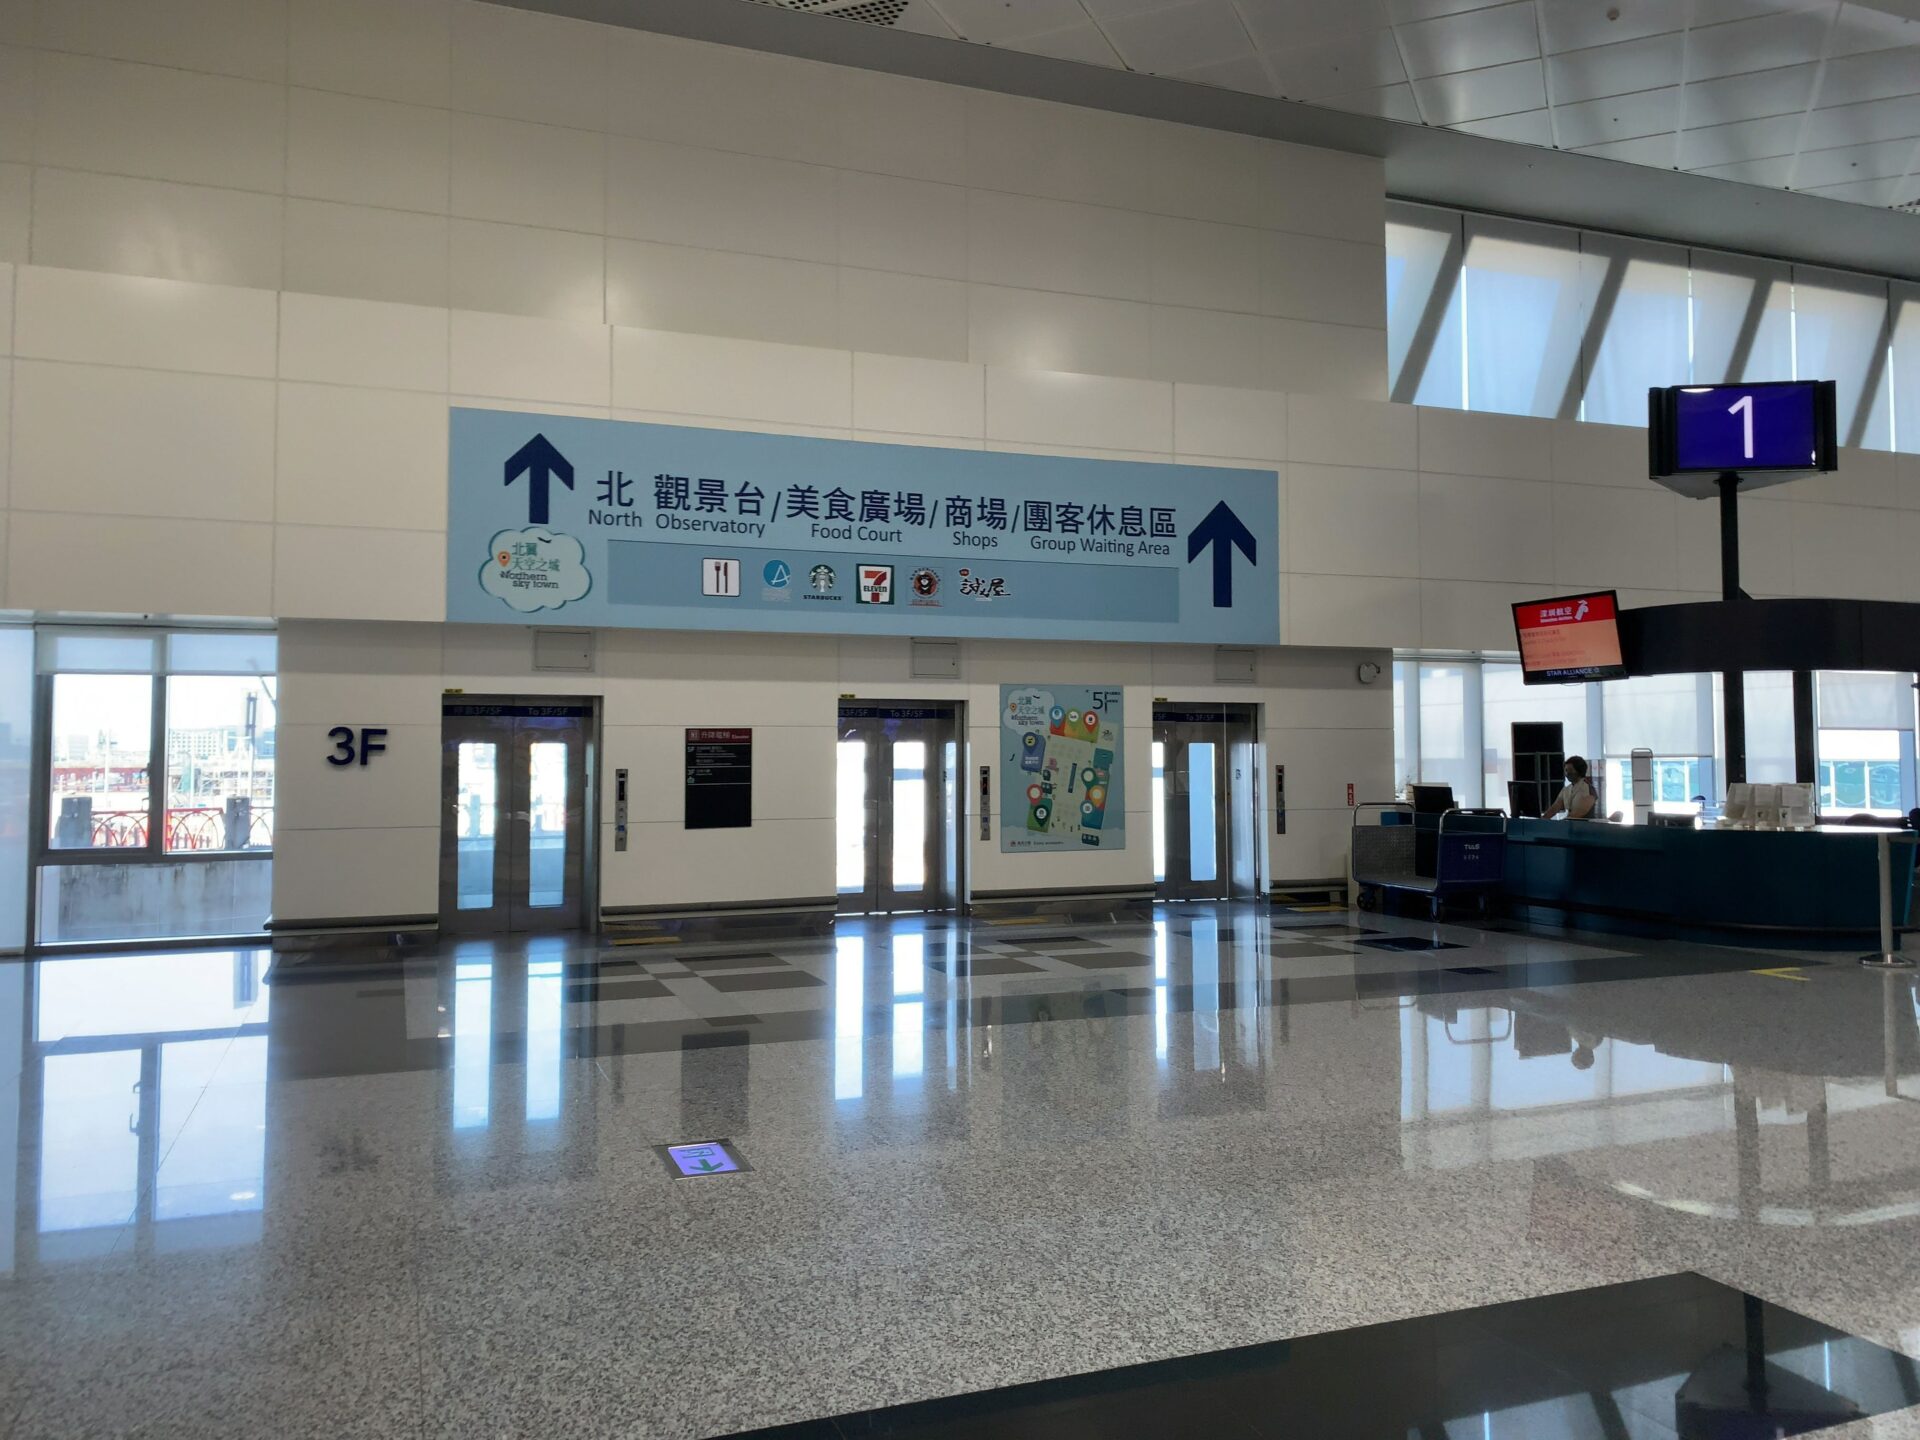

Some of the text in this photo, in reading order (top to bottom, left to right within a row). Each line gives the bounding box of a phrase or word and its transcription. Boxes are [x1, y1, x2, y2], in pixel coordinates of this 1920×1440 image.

[1727, 395, 1754, 459] 1
[597, 470, 634, 507] 北
[588, 509, 766, 538] North Observatory
[811, 523, 903, 543] Food Court
[953, 531, 998, 550] Shops
[1030, 535, 1170, 557] Group Waiting Area
[512, 580, 559, 590] sky town
[1563, 668, 1593, 676] ALLIANCE
[326, 726, 388, 767] 3F
